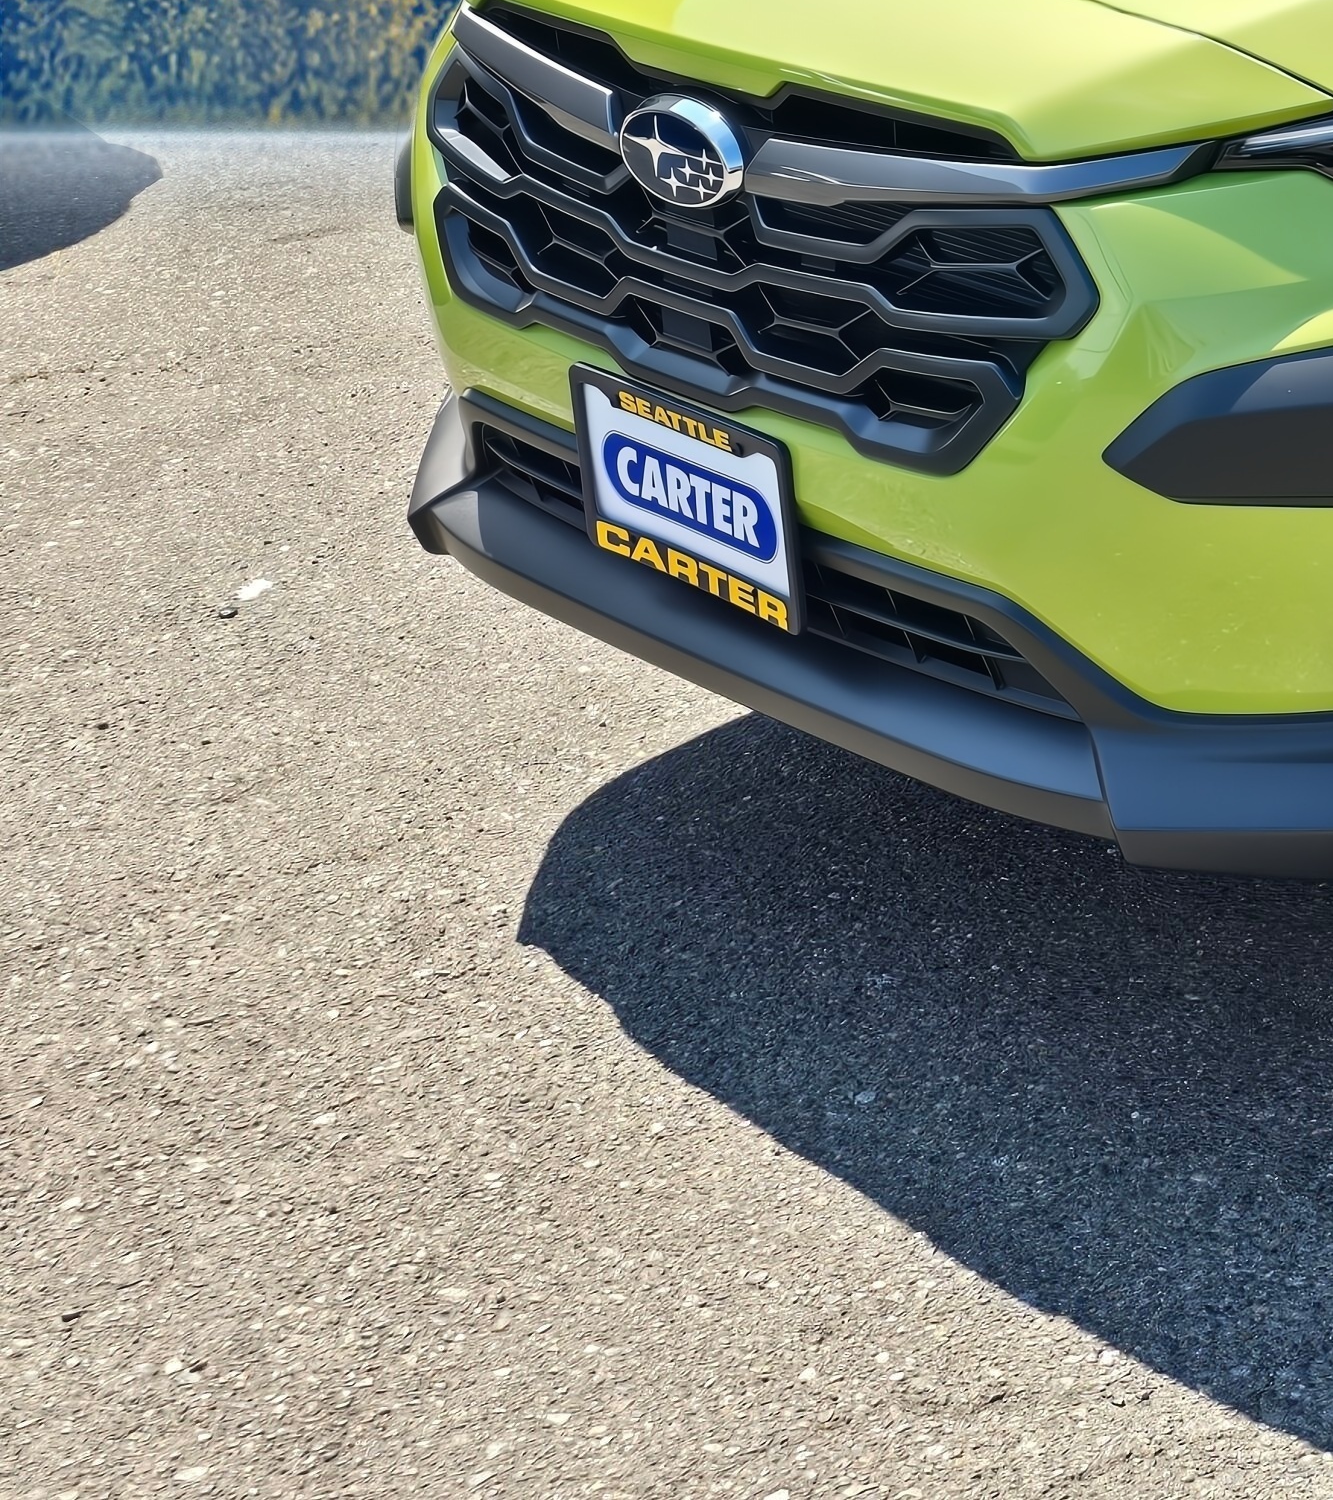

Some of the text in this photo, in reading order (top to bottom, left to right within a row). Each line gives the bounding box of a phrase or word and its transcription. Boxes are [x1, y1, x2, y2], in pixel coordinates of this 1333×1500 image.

[618, 390, 732, 452] SEATTLE
[616, 446, 760, 548] CARTER
[596, 520, 789, 631] CARTER
